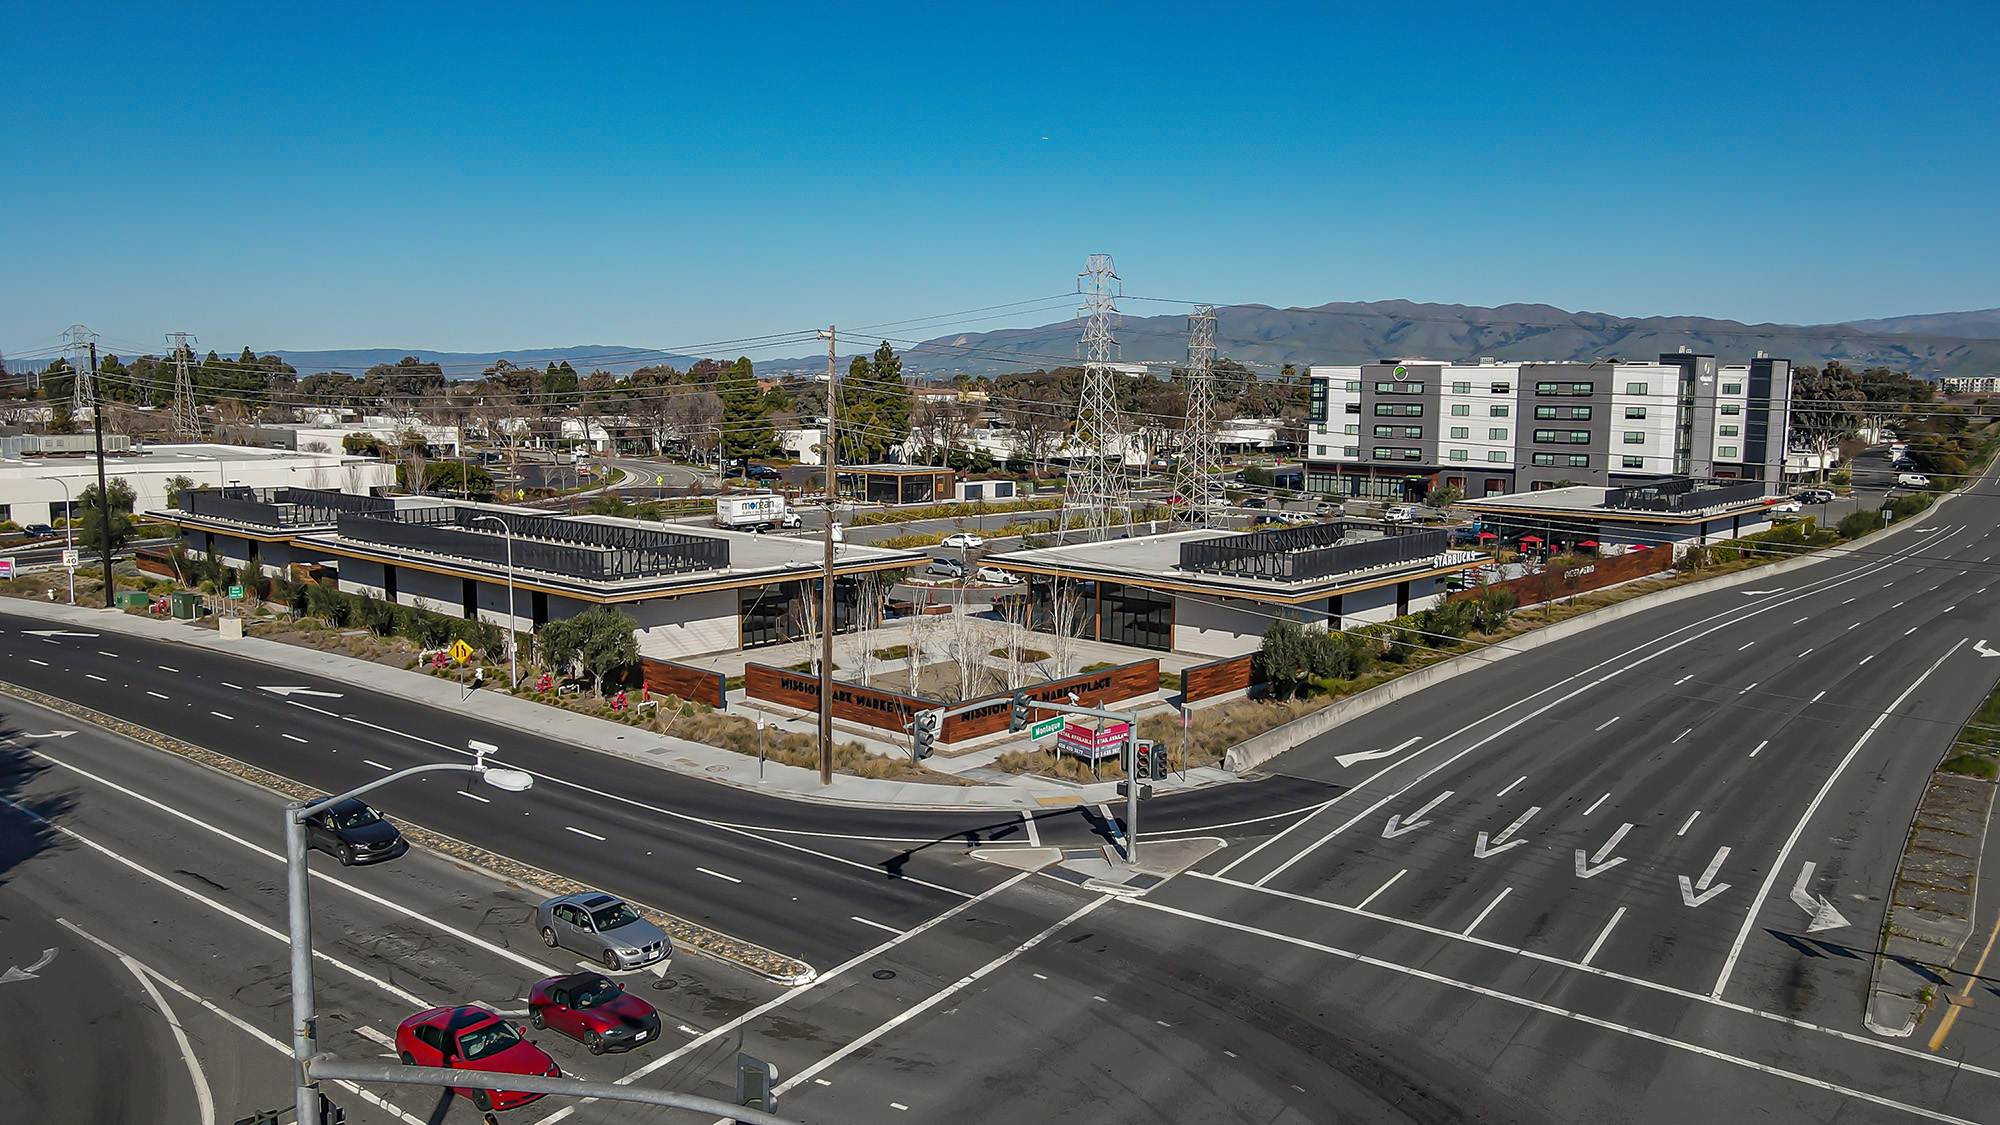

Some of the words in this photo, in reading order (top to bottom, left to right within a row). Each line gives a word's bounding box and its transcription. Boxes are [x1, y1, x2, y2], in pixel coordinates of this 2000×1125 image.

[1433, 550, 1475, 568] STARBUCKS
[961, 702, 1008, 722] MISSION
[1042, 677, 1112, 702] MARKETPLACE
[1035, 722, 1061, 736] Montague
